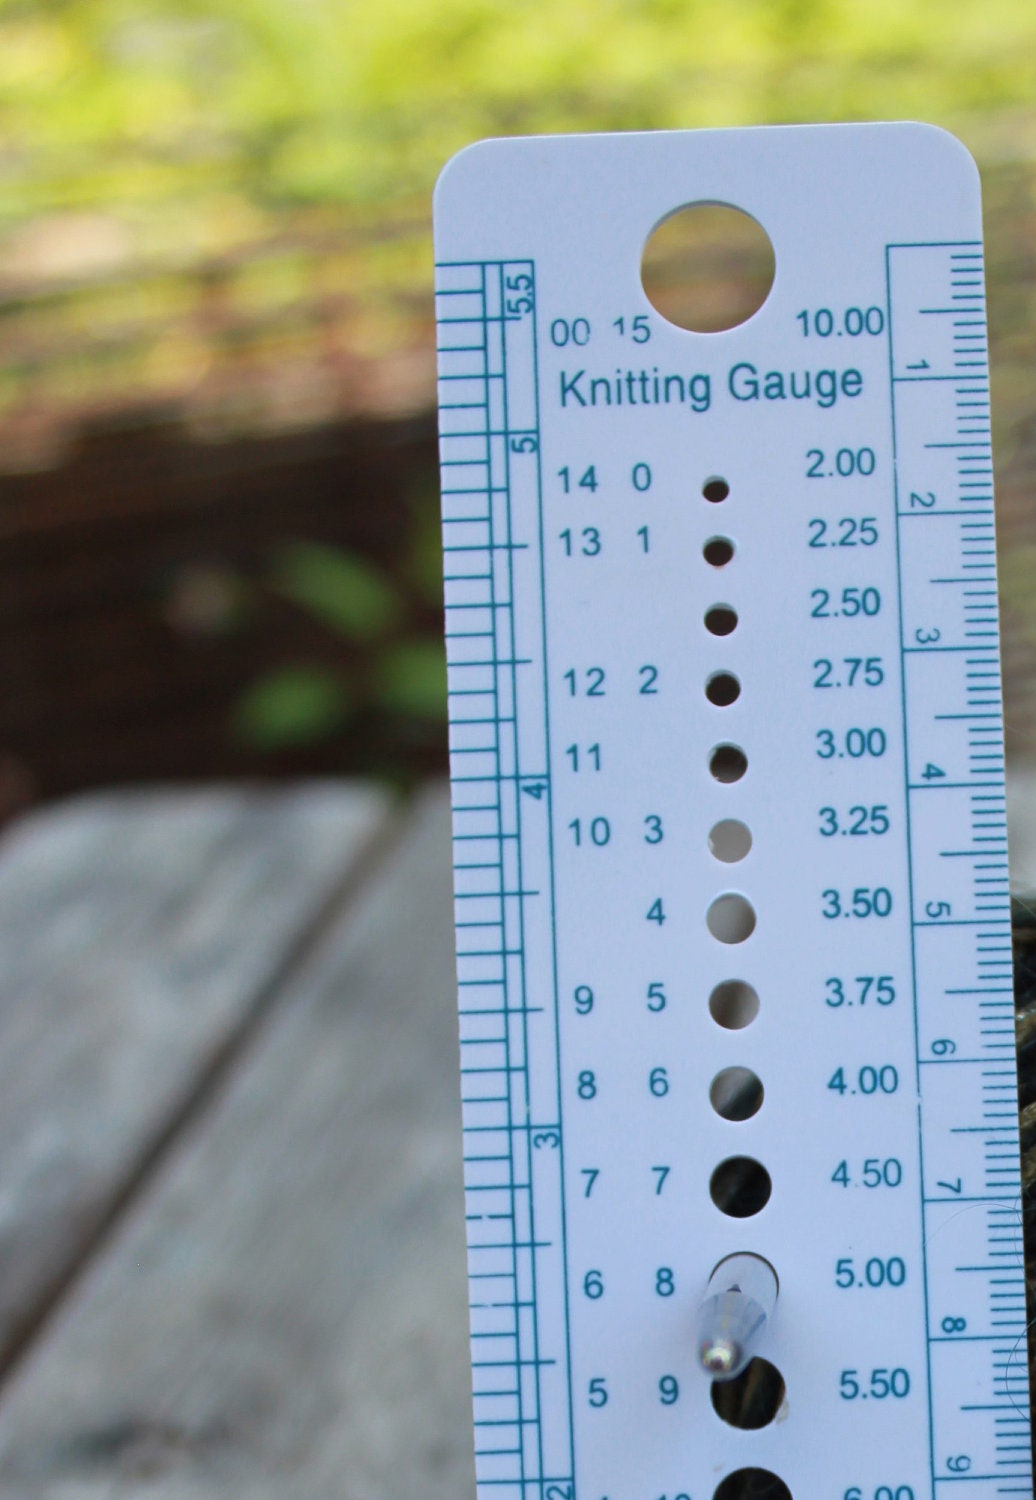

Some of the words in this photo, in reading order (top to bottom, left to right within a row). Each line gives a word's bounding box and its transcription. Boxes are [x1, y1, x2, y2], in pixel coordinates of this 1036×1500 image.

[506, 273, 533, 315] 5.5
[550, 318, 590, 347] 00
[613, 315, 651, 344] 15
[796, 306, 884, 337] 10.00
[906, 359, 931, 370] 1
[560, 367, 711, 413] Knitting
[728, 362, 863, 408] Gauge
[511, 436, 538, 453] 5
[558, 465, 598, 493] 14
[632, 462, 651, 491] 0
[806, 447, 876, 478] 2.00
[910, 492, 936, 508] 2
[559, 527, 601, 556] 13
[637, 525, 648, 553] 1
[808, 517, 878, 548] 2.25
[811, 587, 881, 618] 2.50
[915, 628, 940, 644] 3
[564, 667, 605, 696] 12
[639, 665, 658, 694] 2
[813, 657, 884, 688] 2.75
[566, 743, 600, 772] 11
[816, 727, 886, 759] 3.00
[921, 763, 946, 781] 4
[521, 782, 548, 799] 4
[569, 817, 611, 846] 10
[645, 815, 663, 844] 3
[819, 805, 890, 837] 3.25
[646, 898, 666, 926] 4
[822, 887, 892, 919] 3.50
[926, 902, 952, 918] 5
[574, 985, 594, 1015] 9
[647, 983, 666, 1012] 5
[826, 976, 896, 1008] 3.75
[931, 1039, 957, 1056] 6
[577, 1070, 597, 1100] 8
[649, 1067, 669, 1097] 6
[827, 1065, 899, 1095] 4.00
[533, 1133, 560, 1150] 3
[581, 1168, 600, 1198] 7
[652, 1166, 670, 1195] 7
[831, 1158, 902, 1188] 4.50
[936, 1177, 962, 1194] 7
[583, 1270, 604, 1300] 6
[655, 1267, 675, 1297] 8
[836, 1256, 906, 1288] 5.00
[941, 1316, 967, 1333] 8
[589, 1378, 608, 1408] 5
[659, 1375, 679, 1405] 9
[840, 1368, 910, 1400] 5.50
[946, 1455, 972, 1472] 9
